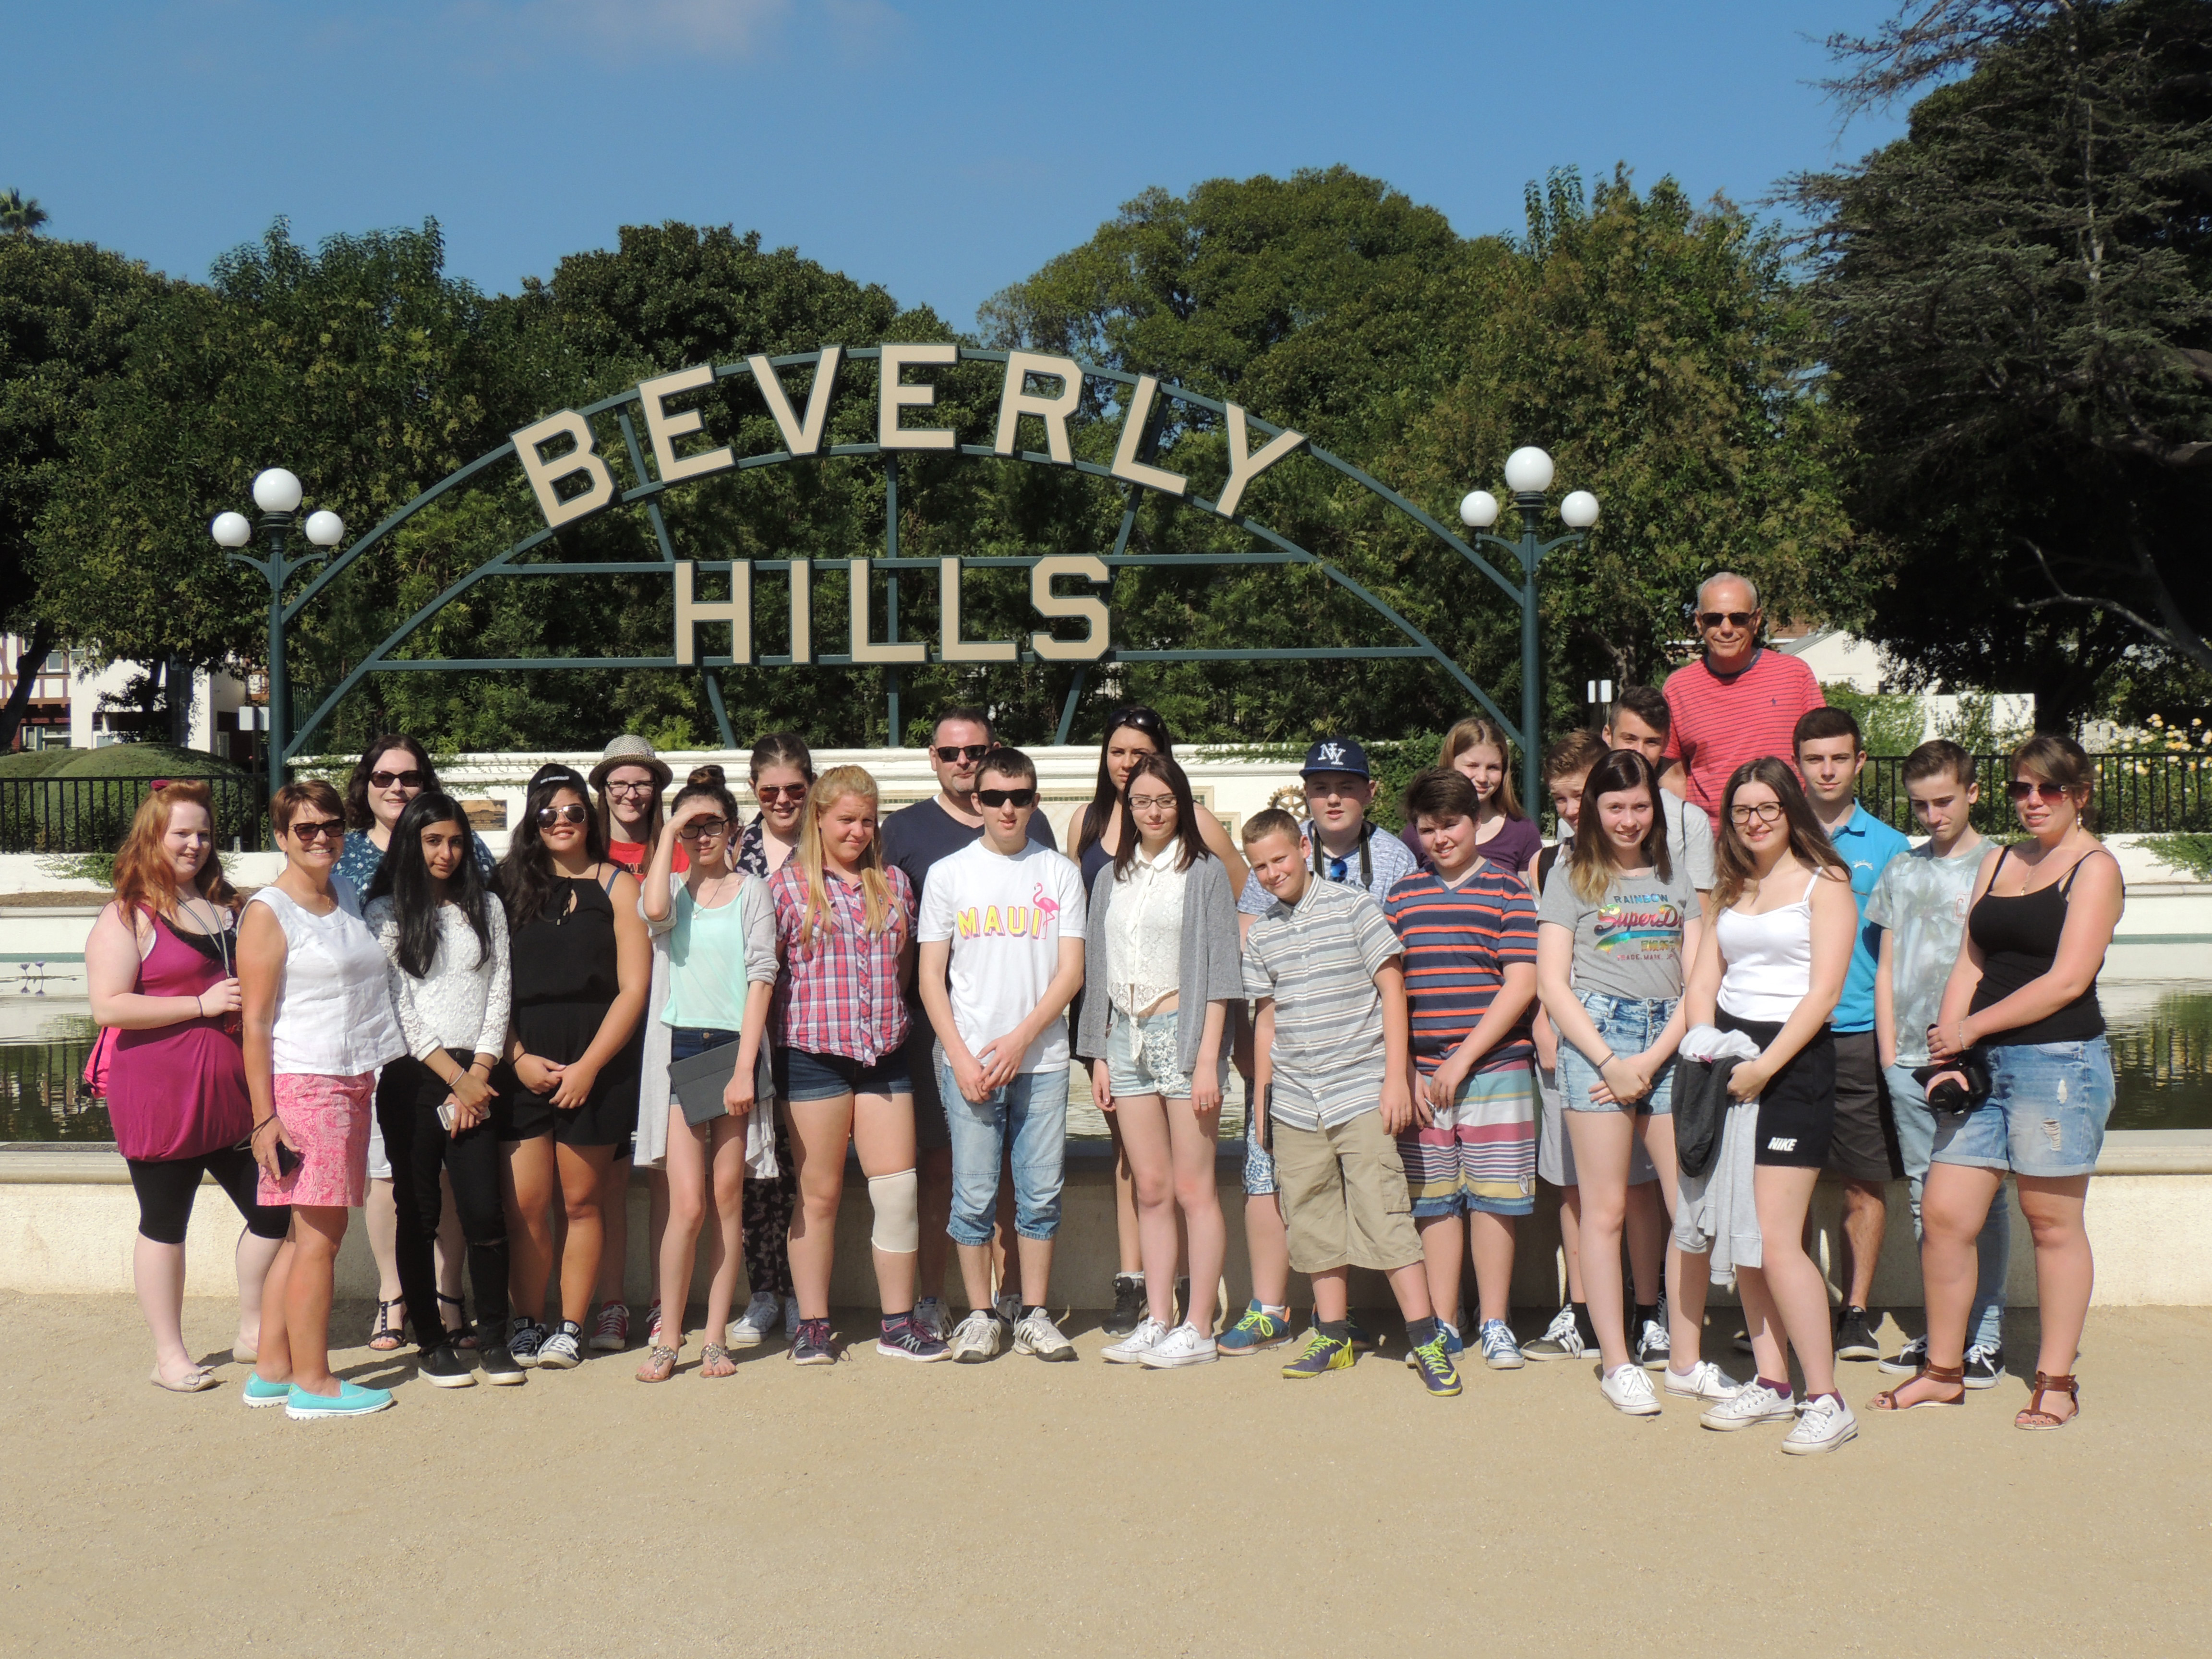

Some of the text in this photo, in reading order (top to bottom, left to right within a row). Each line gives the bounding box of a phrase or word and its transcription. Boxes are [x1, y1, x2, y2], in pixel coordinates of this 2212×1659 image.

[511, 344, 1306, 529] BEVERLY
[673, 555, 1111, 665] HILLS
[1318, 743, 1346, 766] NY
[1613, 893, 1669, 904] RAINBOW
[957, 905, 1044, 940] MAUI
[1767, 1137, 1798, 1151] NIKE
